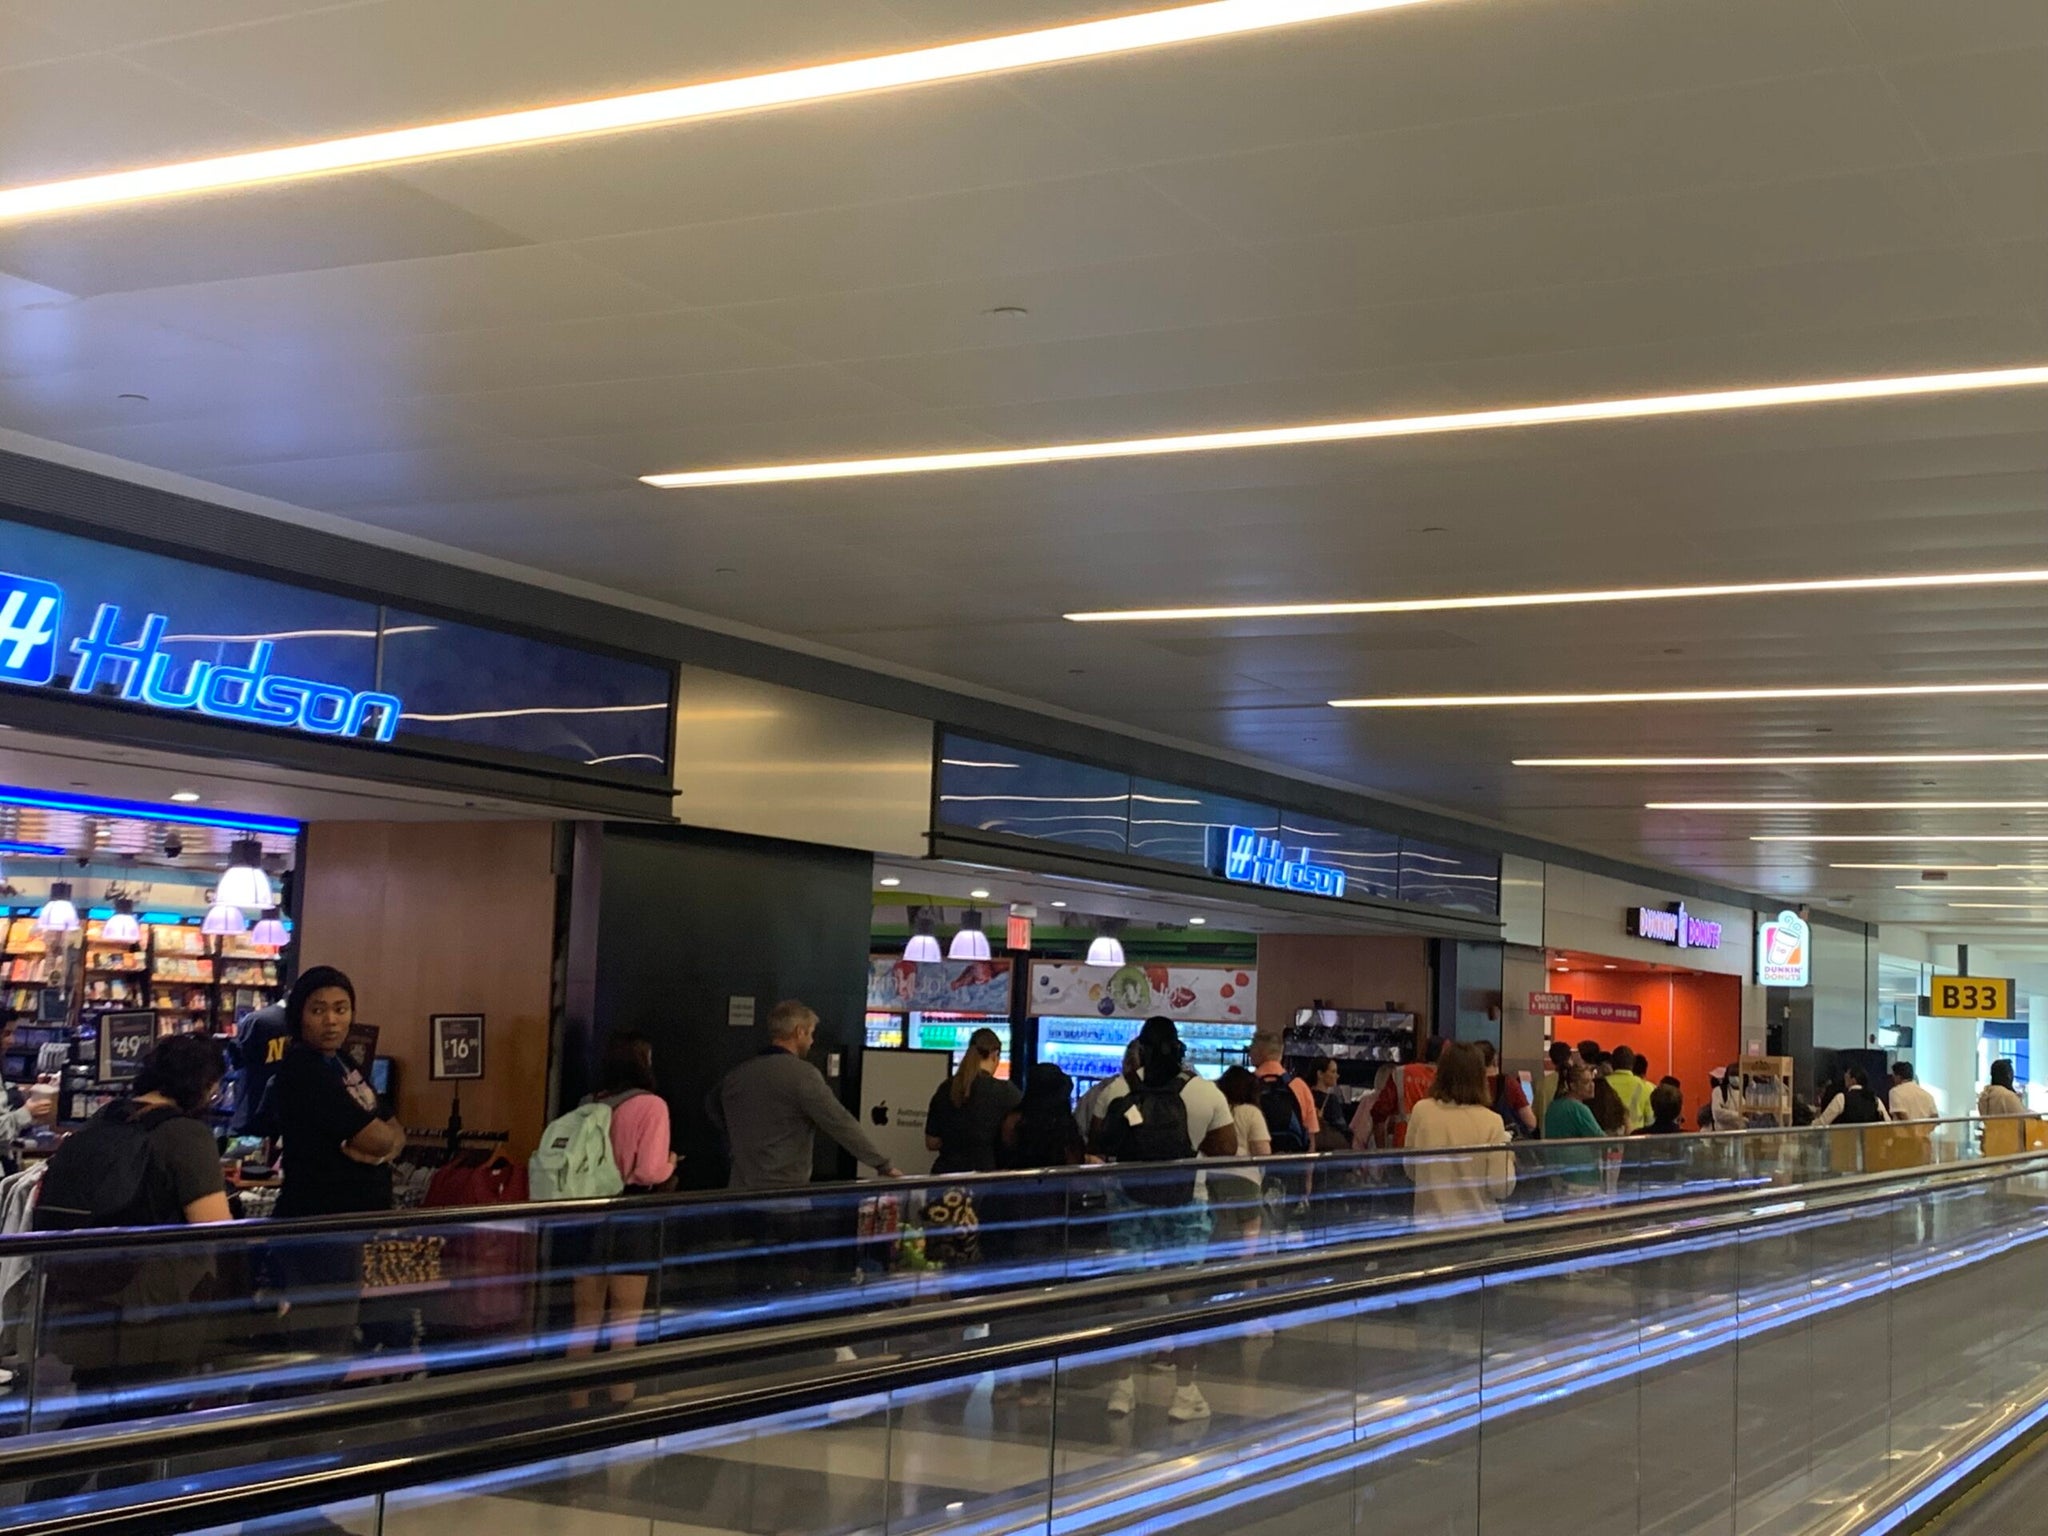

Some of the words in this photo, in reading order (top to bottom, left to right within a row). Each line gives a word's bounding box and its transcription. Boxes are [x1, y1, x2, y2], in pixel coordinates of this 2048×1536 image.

[70, 602, 402, 743] Hudson
[1252, 836, 1345, 898] Hudson
[1688, 916, 1721, 949] DONUTS
[1764, 973, 1801, 981] DONUTS
[1534, 994, 1566, 1002] ORDER
[1538, 1002, 1562, 1011] HERE
[1943, 985, 1996, 1011] B33
[1600, 1007, 1614, 1016] UP
[1615, 1009, 1639, 1019] HERE
